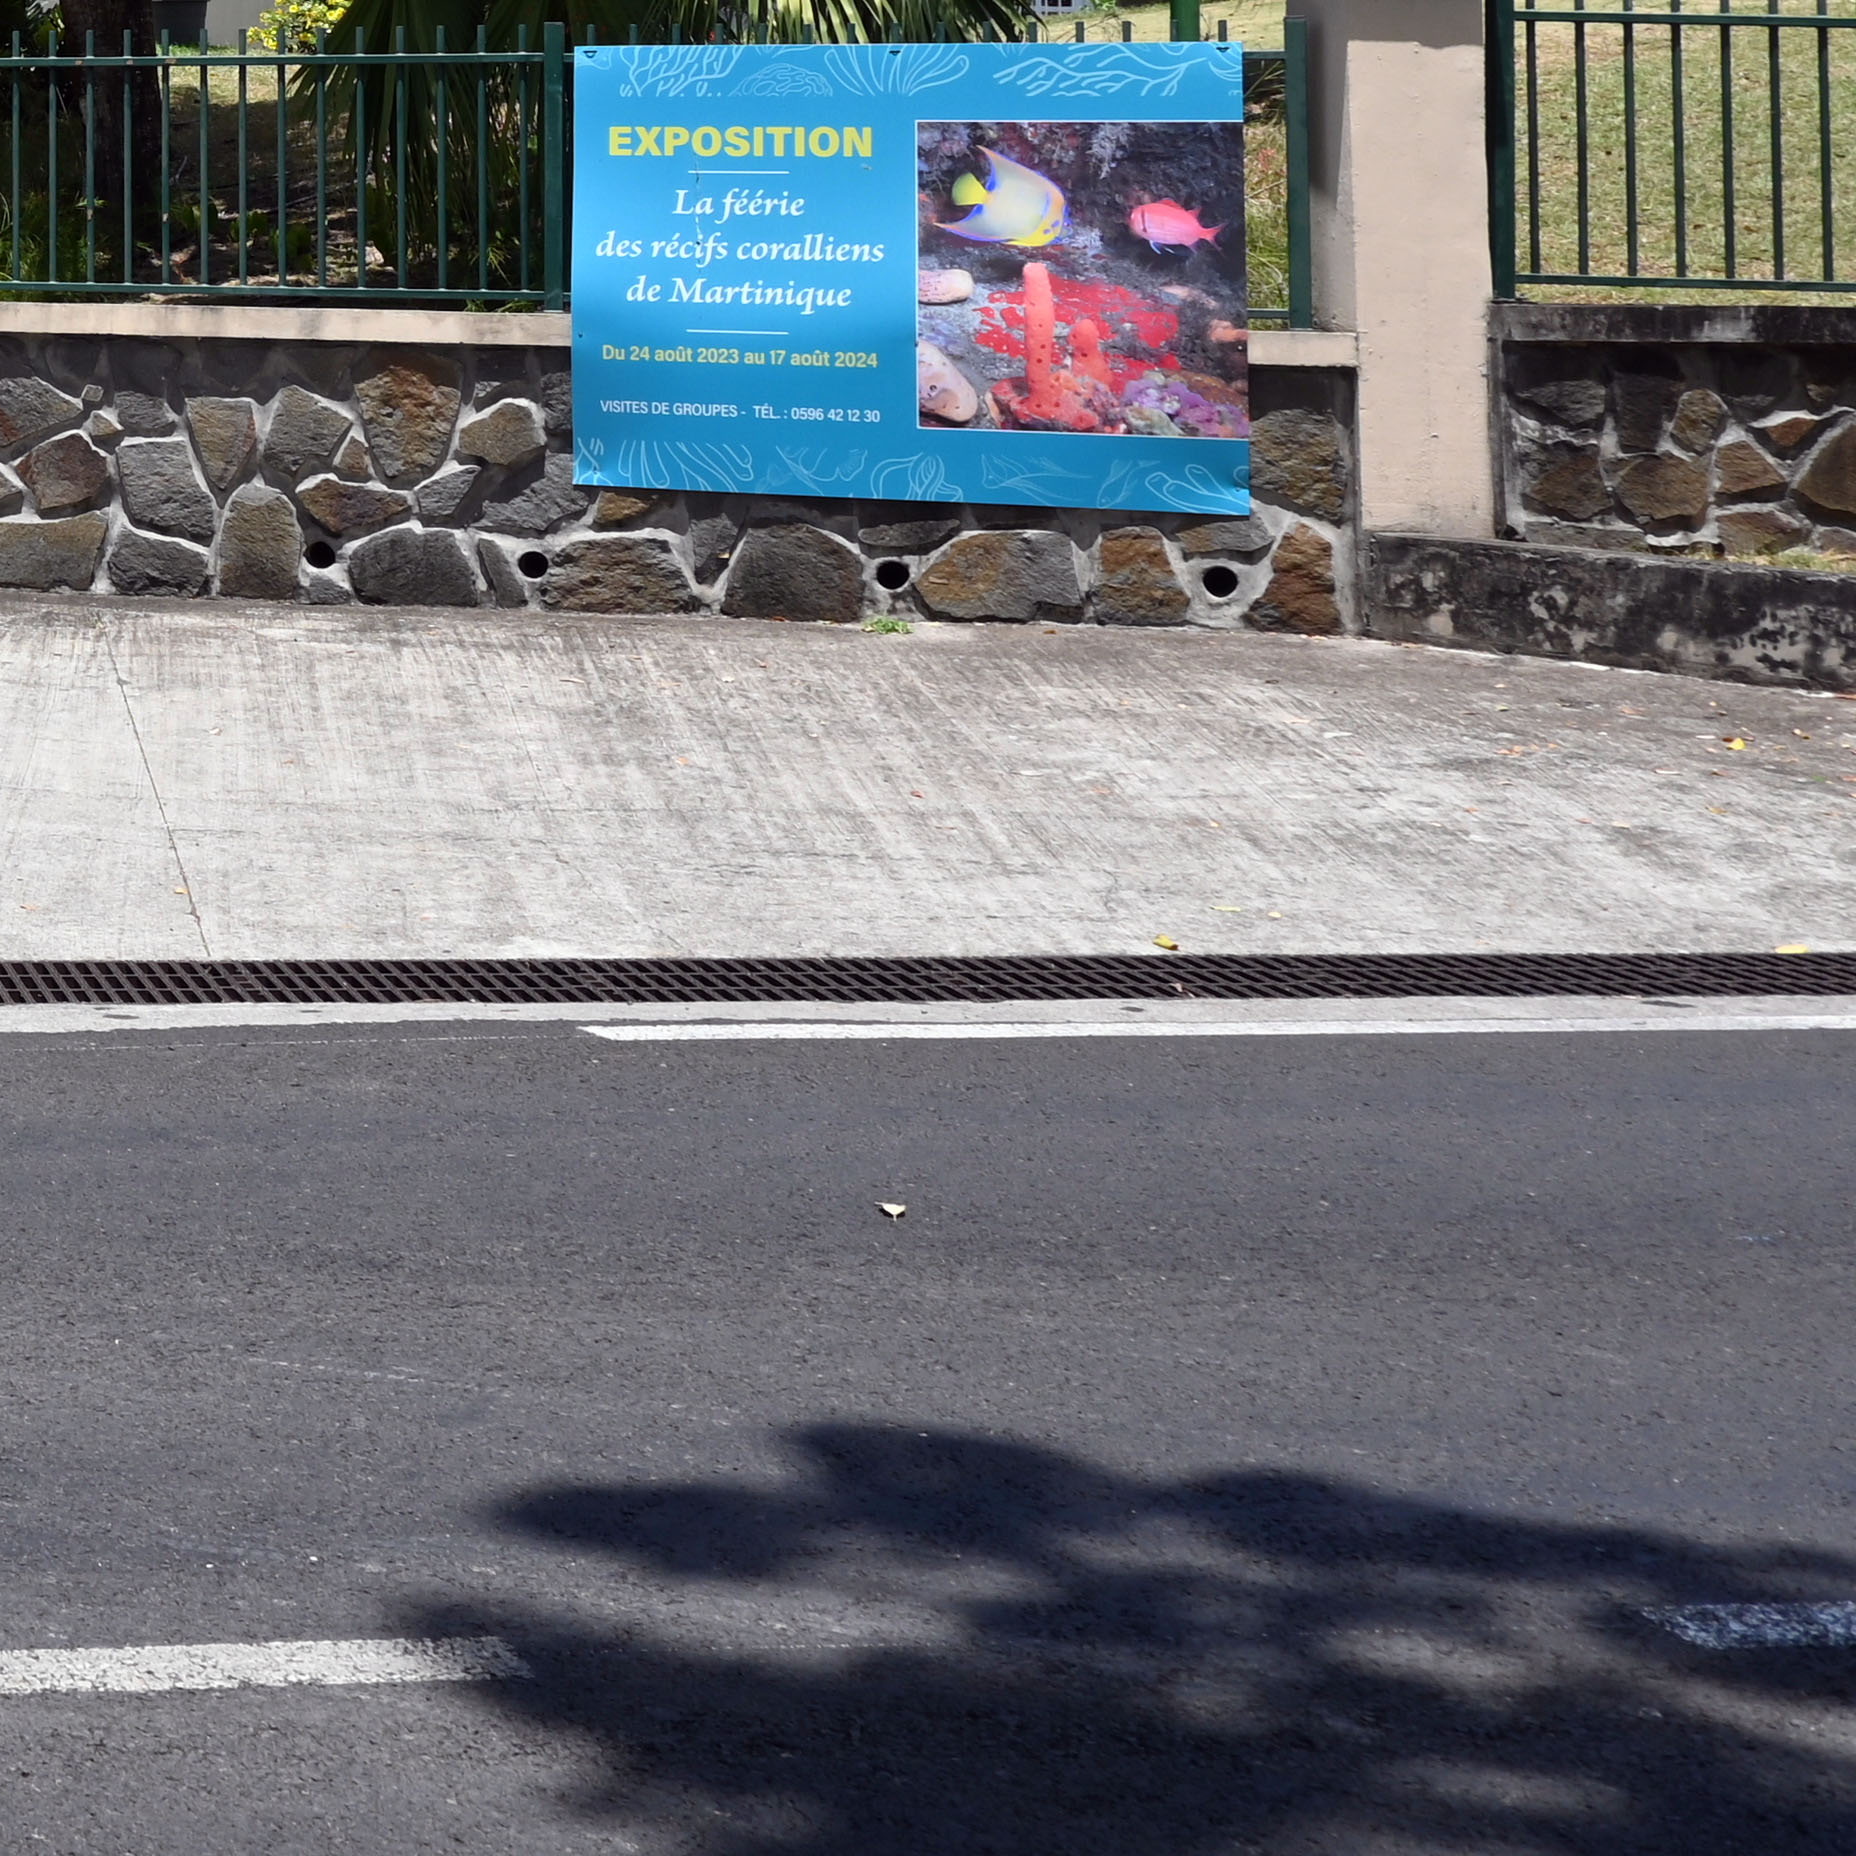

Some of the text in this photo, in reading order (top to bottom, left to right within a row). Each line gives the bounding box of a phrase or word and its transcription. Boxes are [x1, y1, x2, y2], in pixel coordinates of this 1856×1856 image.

[608, 126, 873, 158] EXPOSITION
[673, 188, 805, 222] La féérie
[595, 231, 884, 267] des récifs coralliens
[627, 277, 852, 315] de Martinique
[602, 345, 878, 369] Du 24 août 2023 au 17 août 2024
[600, 401, 647, 415] VISITES
[650, 403, 668, 416] DE
[672, 403, 737, 418] GROUPES
[753, 403, 781, 419] TÉL.
[791, 407, 824, 421] 0596
[828, 408, 844, 422] 42
[847, 409, 860, 422] 12
[864, 410, 880, 423] 30
